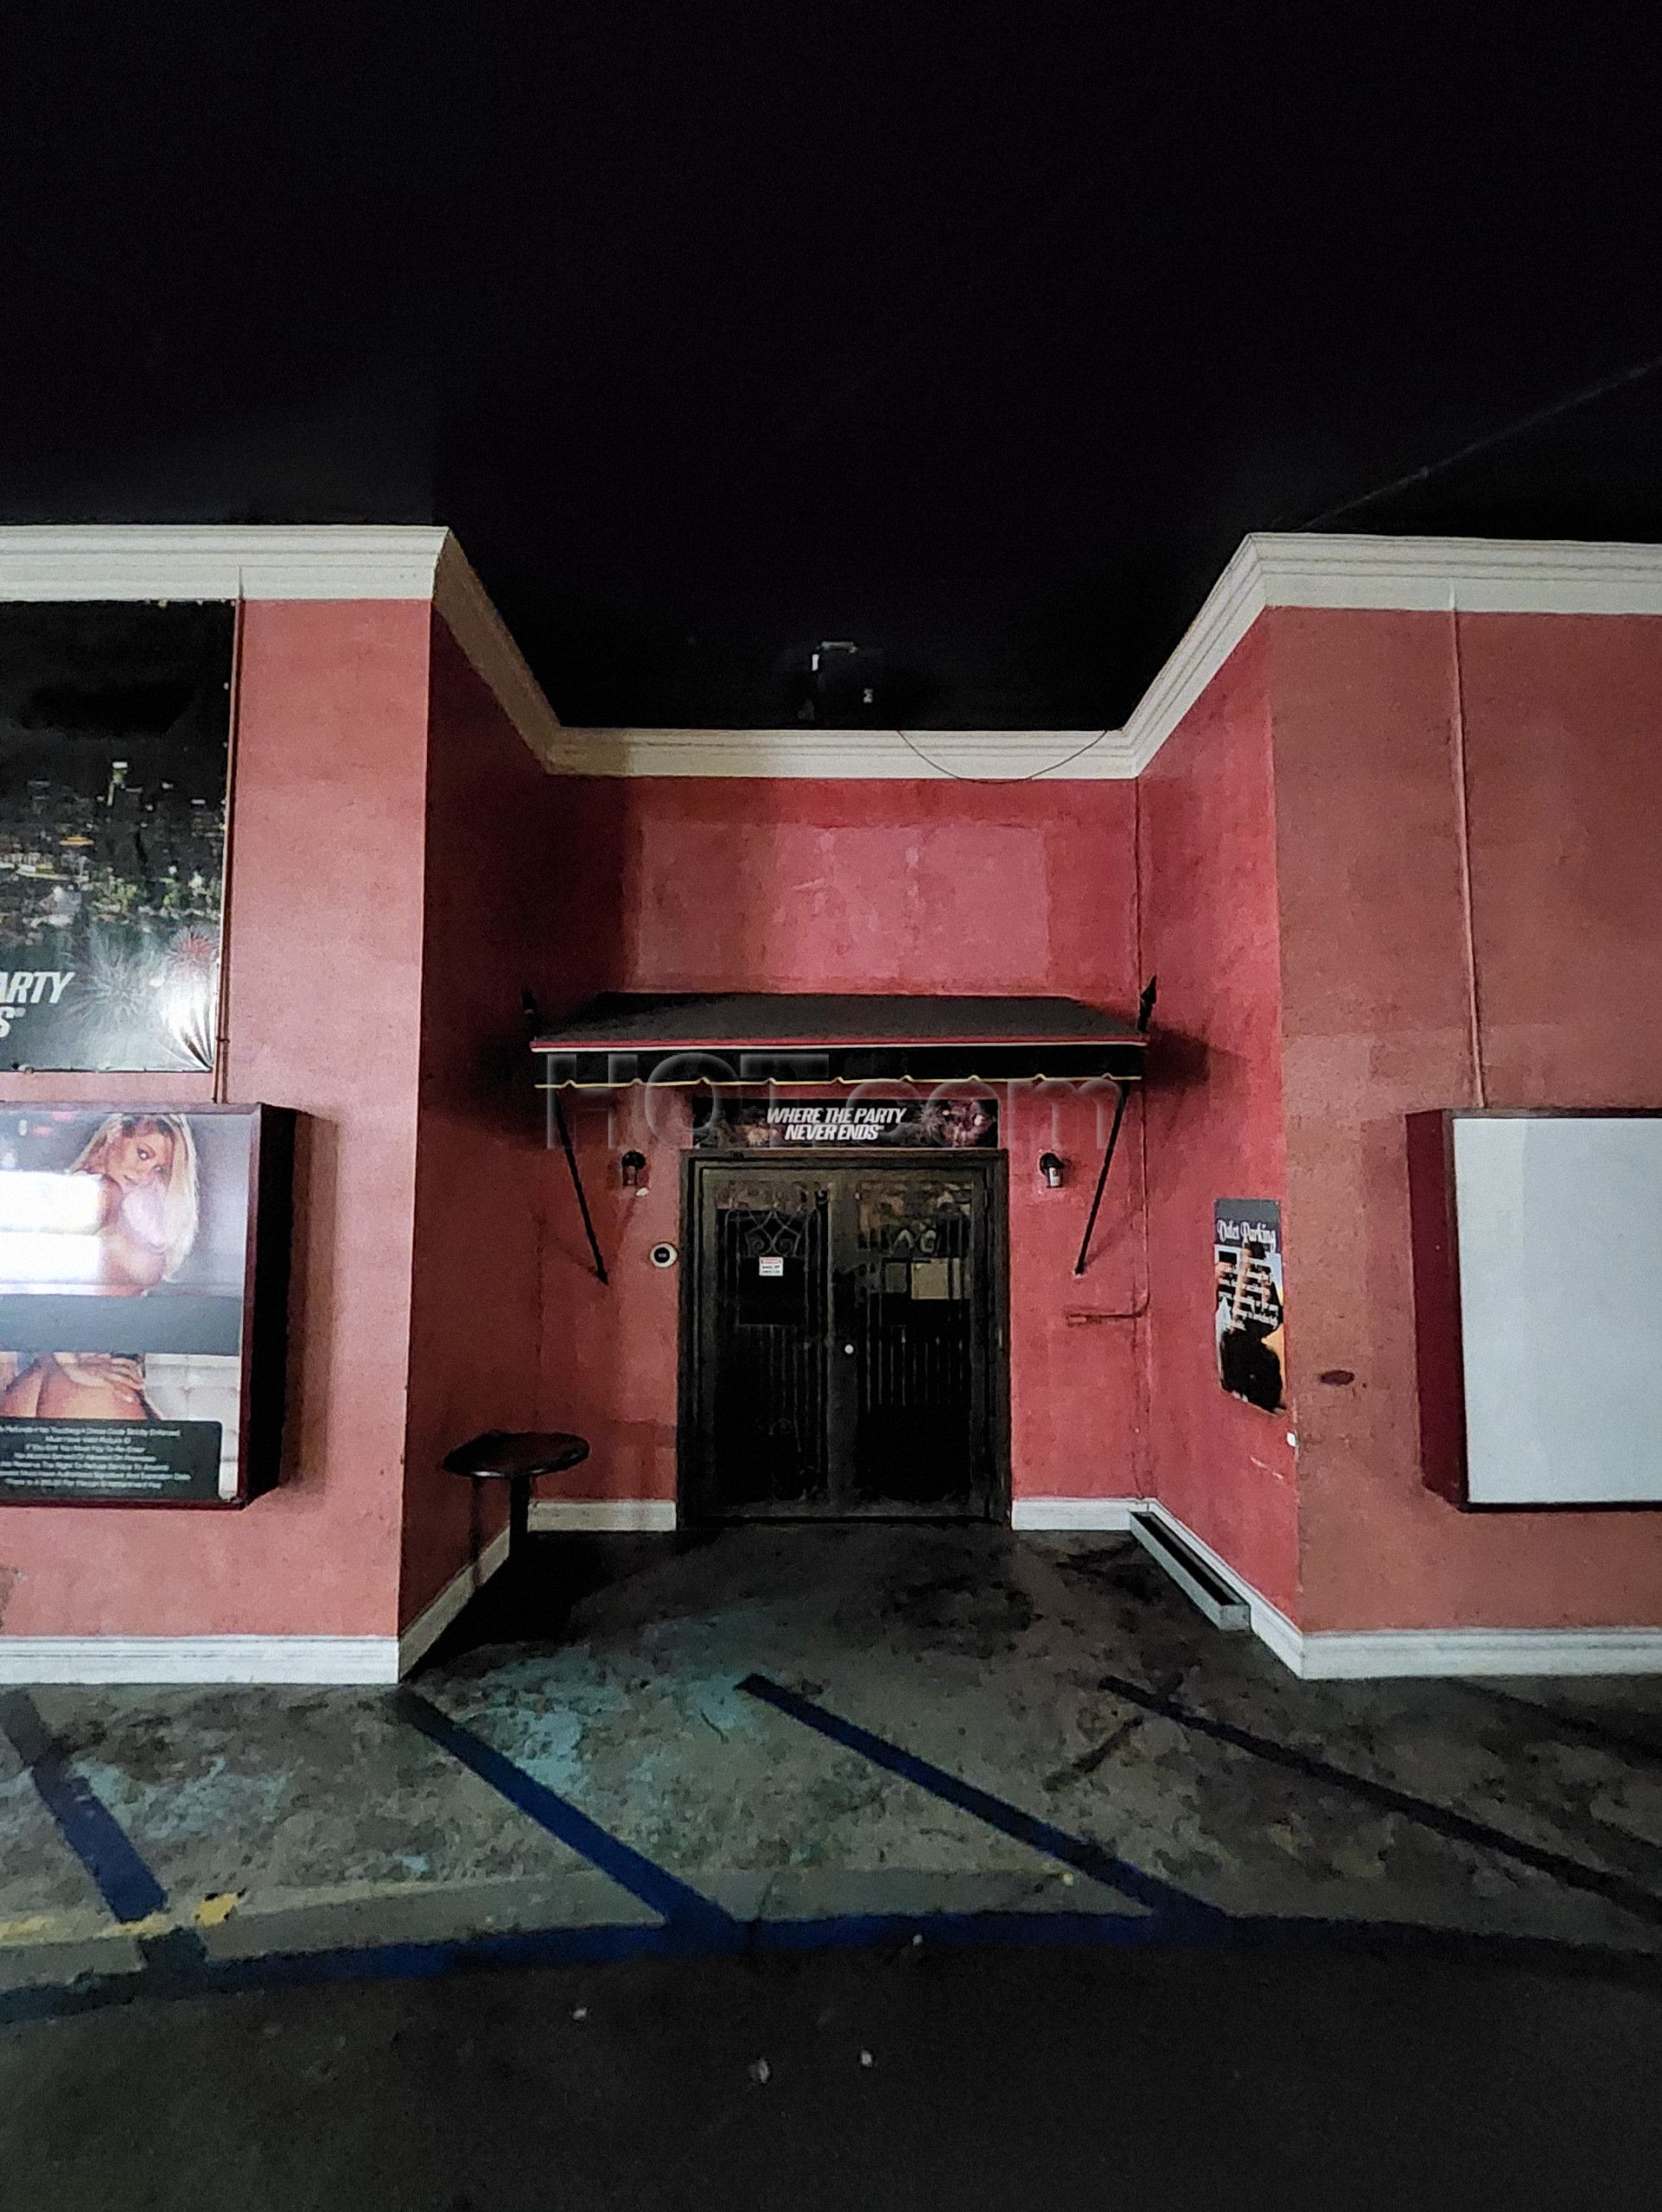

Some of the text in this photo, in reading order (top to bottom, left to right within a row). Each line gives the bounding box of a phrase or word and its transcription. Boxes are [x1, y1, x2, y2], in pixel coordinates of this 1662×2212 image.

[767, 1107, 907, 1124] WHERE THE PARTY
[784, 1124, 837, 1141] NEVER
